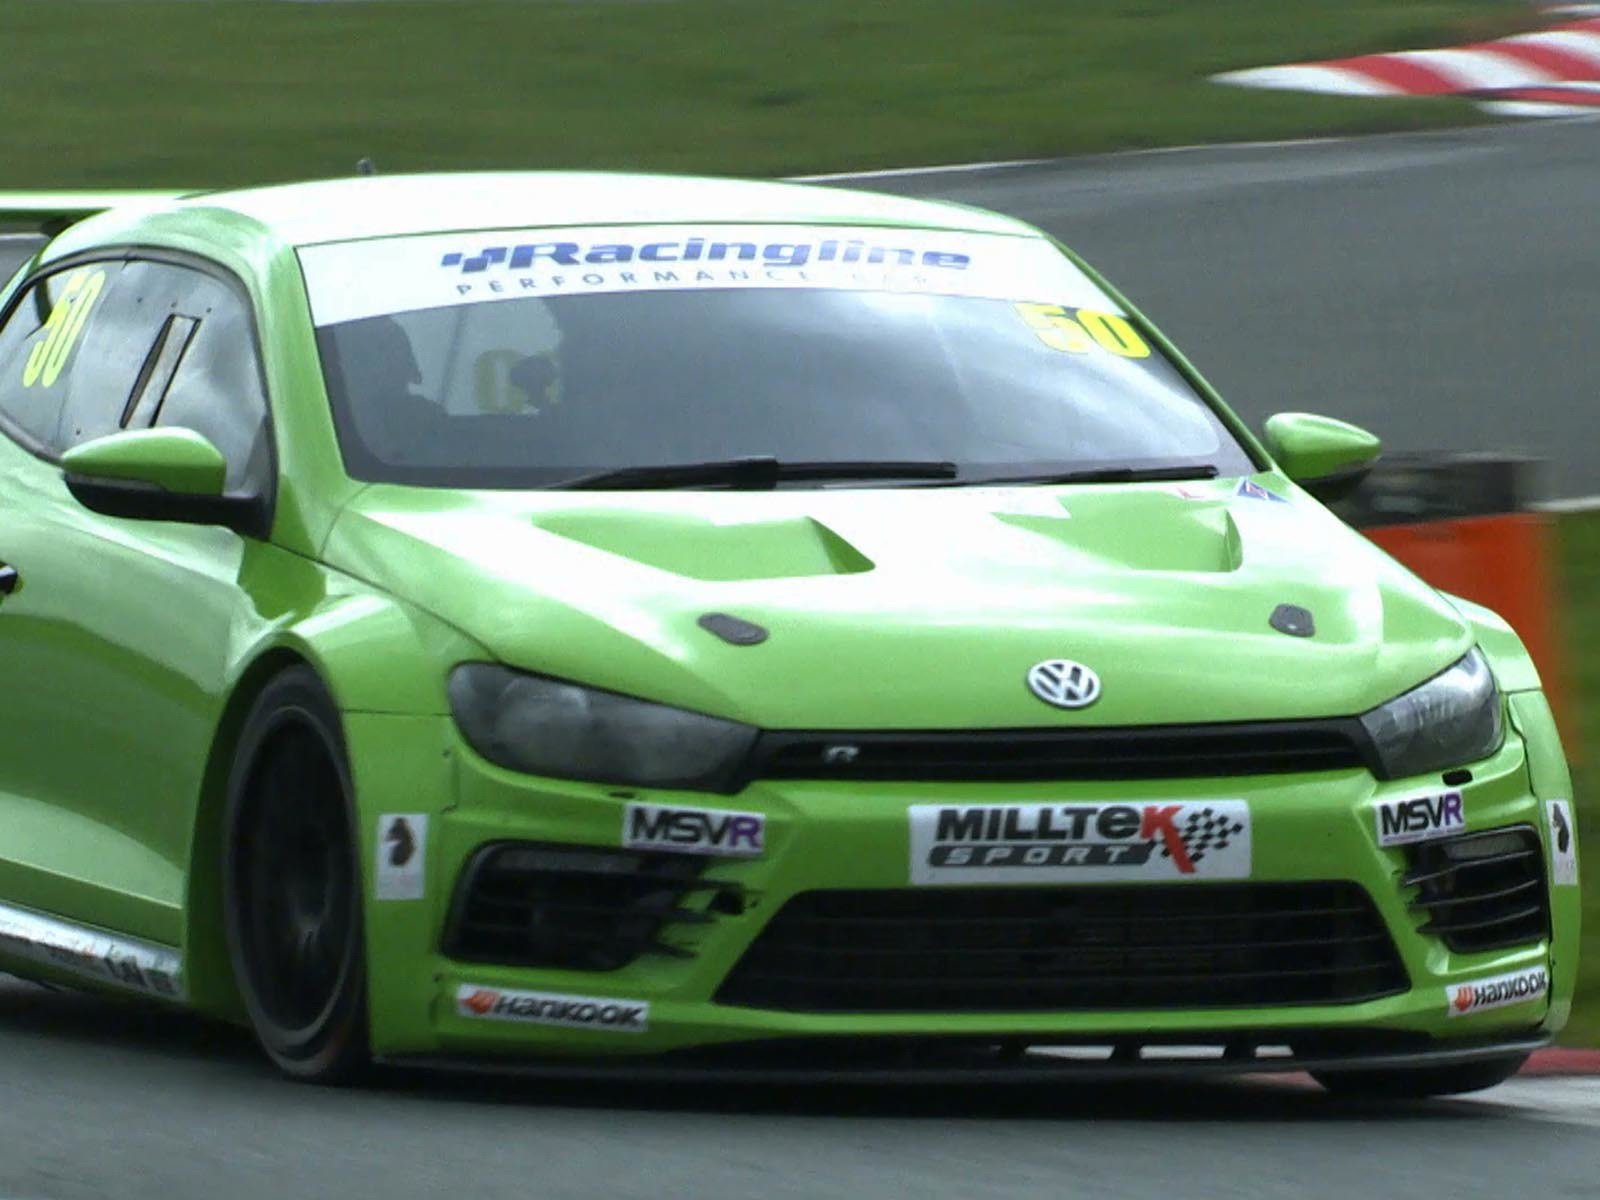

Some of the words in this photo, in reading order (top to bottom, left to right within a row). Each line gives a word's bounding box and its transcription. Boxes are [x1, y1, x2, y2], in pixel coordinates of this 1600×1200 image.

[509, 237, 970, 269] Racingline
[23, 270, 106, 388] 50
[1013, 304, 1151, 358] 50
[632, 808, 761, 847] MSVR
[1381, 792, 1463, 835] MSVR
[943, 847, 1132, 865] SPORT
